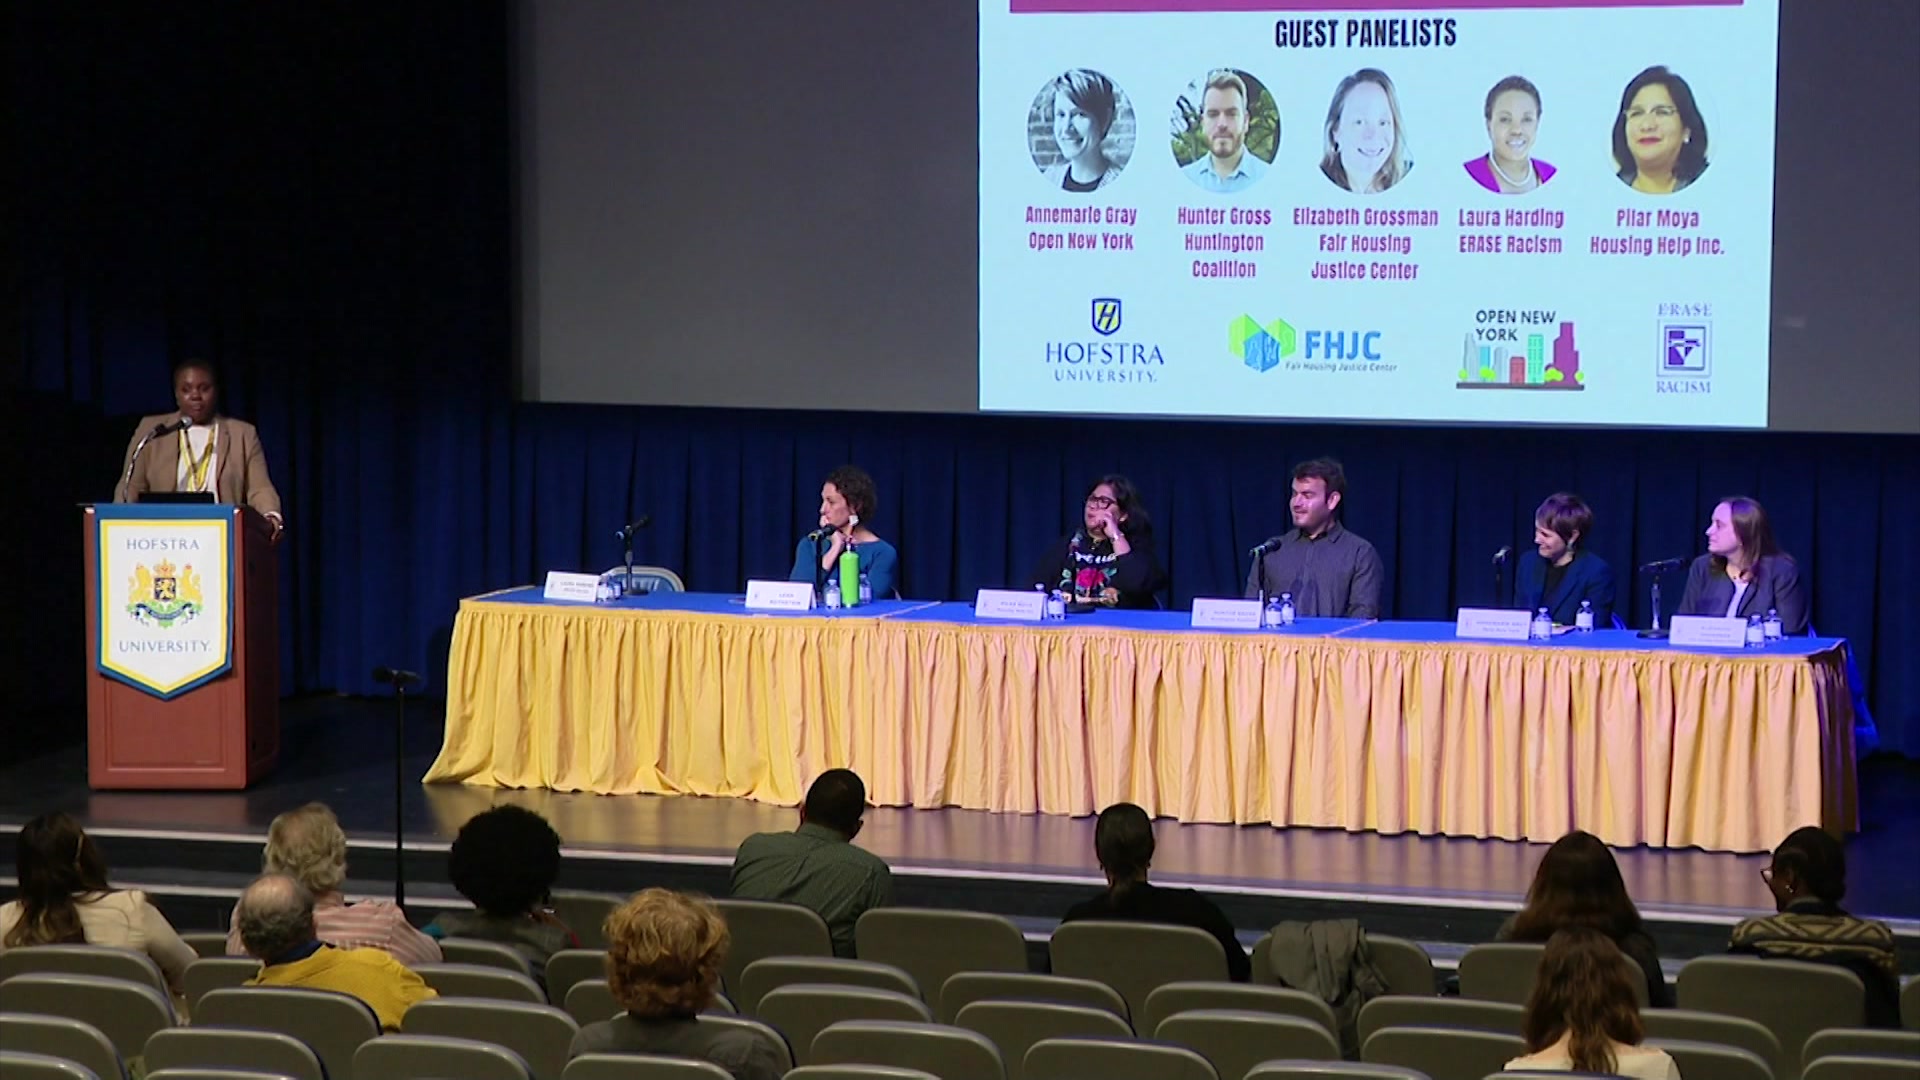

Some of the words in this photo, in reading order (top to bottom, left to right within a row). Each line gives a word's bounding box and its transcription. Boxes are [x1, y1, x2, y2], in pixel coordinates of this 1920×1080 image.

[1275, 19, 1339, 48] GUEST
[1346, 18, 1457, 48] PANELISTS
[1025, 205, 1101, 224] Annemarie
[1105, 206, 1138, 227] Gray
[1177, 206, 1226, 225] Hunter
[1230, 207, 1272, 225] Gross
[1293, 207, 1360, 225] Elizabeth
[1364, 208, 1439, 226] Grossman
[1458, 208, 1501, 227] Laura
[1505, 208, 1565, 229] Harding
[1616, 208, 1652, 227] Pilar
[1657, 209, 1700, 229] Moya
[1029, 232, 1064, 251] Open
[1068, 232, 1097, 249] New
[1102, 232, 1134, 250] York
[1184, 233, 1264, 253] Huntington
[1319, 233, 1347, 252] Fair
[1351, 234, 1412, 255] Housing
[1459, 235, 1502, 253] ERASE
[1506, 235, 1563, 254] Racism
[1590, 235, 1653, 257] Housing
[1657, 236, 1692, 257] Help
[1695, 236, 1726, 255] Inc.
[1192, 260, 1257, 278] Coalition
[1311, 261, 1366, 279] Justice
[1370, 261, 1419, 280] Center
[1475, 309, 1517, 324] OPEN
[1521, 310, 1556, 324] NEW
[1658, 302, 1712, 317] ERASE
[1475, 327, 1519, 342] YORK
[1045, 341, 1164, 366] HOFSTRA
[1305, 330, 1382, 361] FHJC
[1303, 362, 1337, 372] Housing
[1369, 363, 1398, 372] Center
[1656, 380, 1711, 394] RACISM
[126, 538, 200, 551] HOFSTRA
